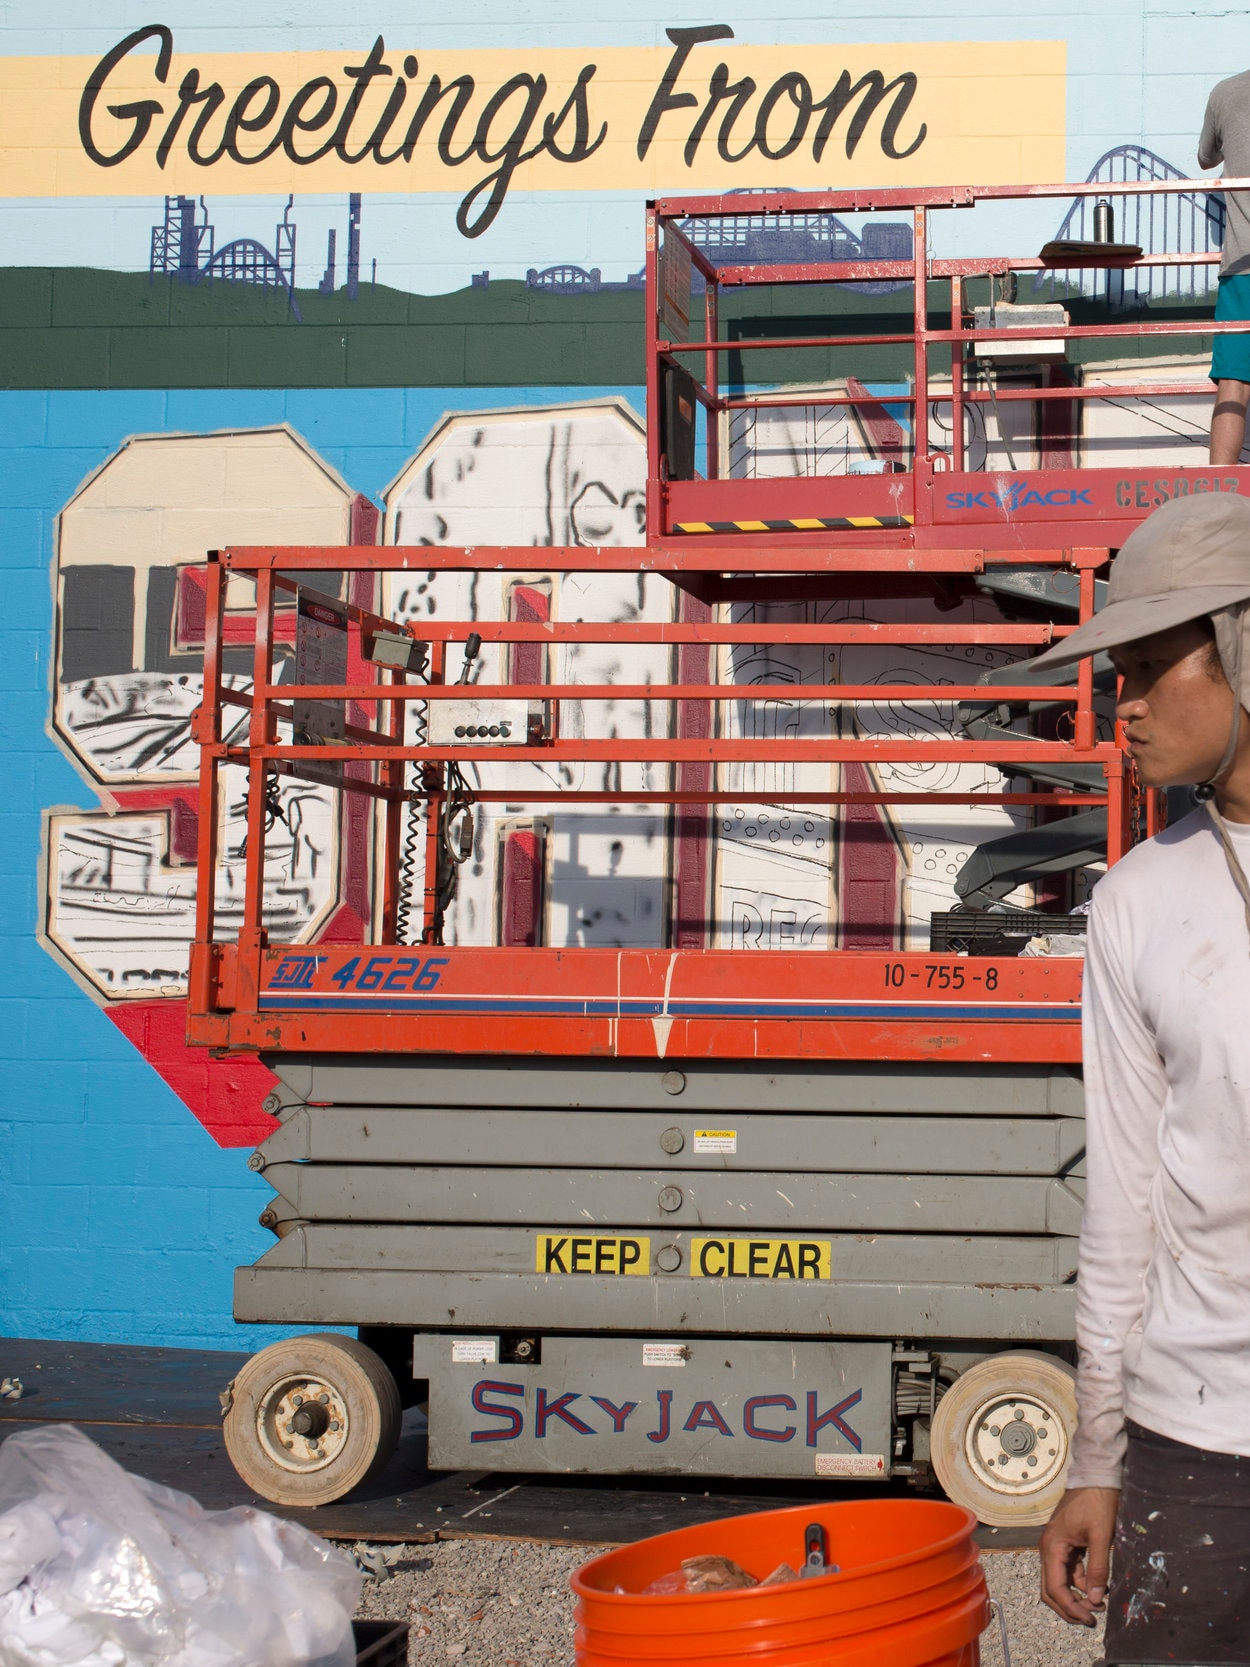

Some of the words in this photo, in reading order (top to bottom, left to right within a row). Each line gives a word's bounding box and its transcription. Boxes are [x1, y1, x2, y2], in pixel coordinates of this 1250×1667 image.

[78, 23, 608, 239] Greetings
[637, 23, 928, 168] From
[945, 481, 1095, 512] SKYJACK
[314, 607, 335, 622] DANGER
[331, 957, 450, 990] 4626
[545, 1238, 641, 1275] KEEP
[700, 1241, 822, 1278] CLEAR
[470, 1380, 863, 1453] SKYJACK
